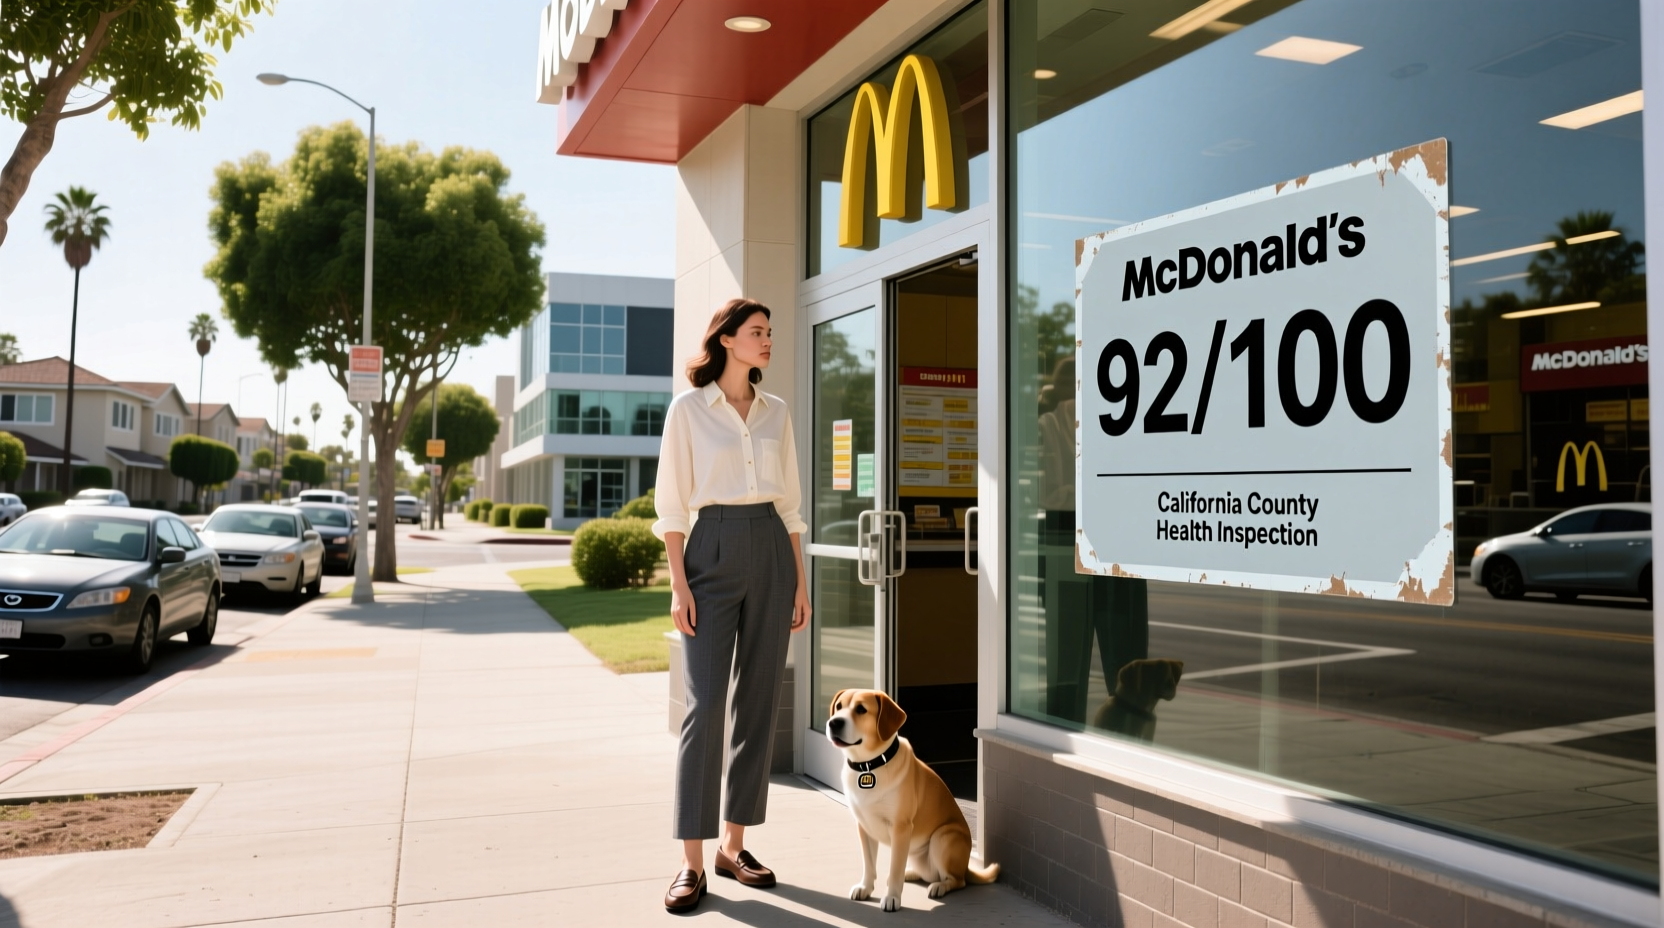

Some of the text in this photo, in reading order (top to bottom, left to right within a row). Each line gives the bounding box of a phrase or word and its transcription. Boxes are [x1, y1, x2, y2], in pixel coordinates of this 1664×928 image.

[1121, 212, 1366, 302] McDonald's
[1096, 298, 1411, 437] 92/100
[1531, 343, 1649, 371] McDonald's
[1157, 490, 1319, 523] California County
[1156, 519, 1318, 549] Health Inspection
